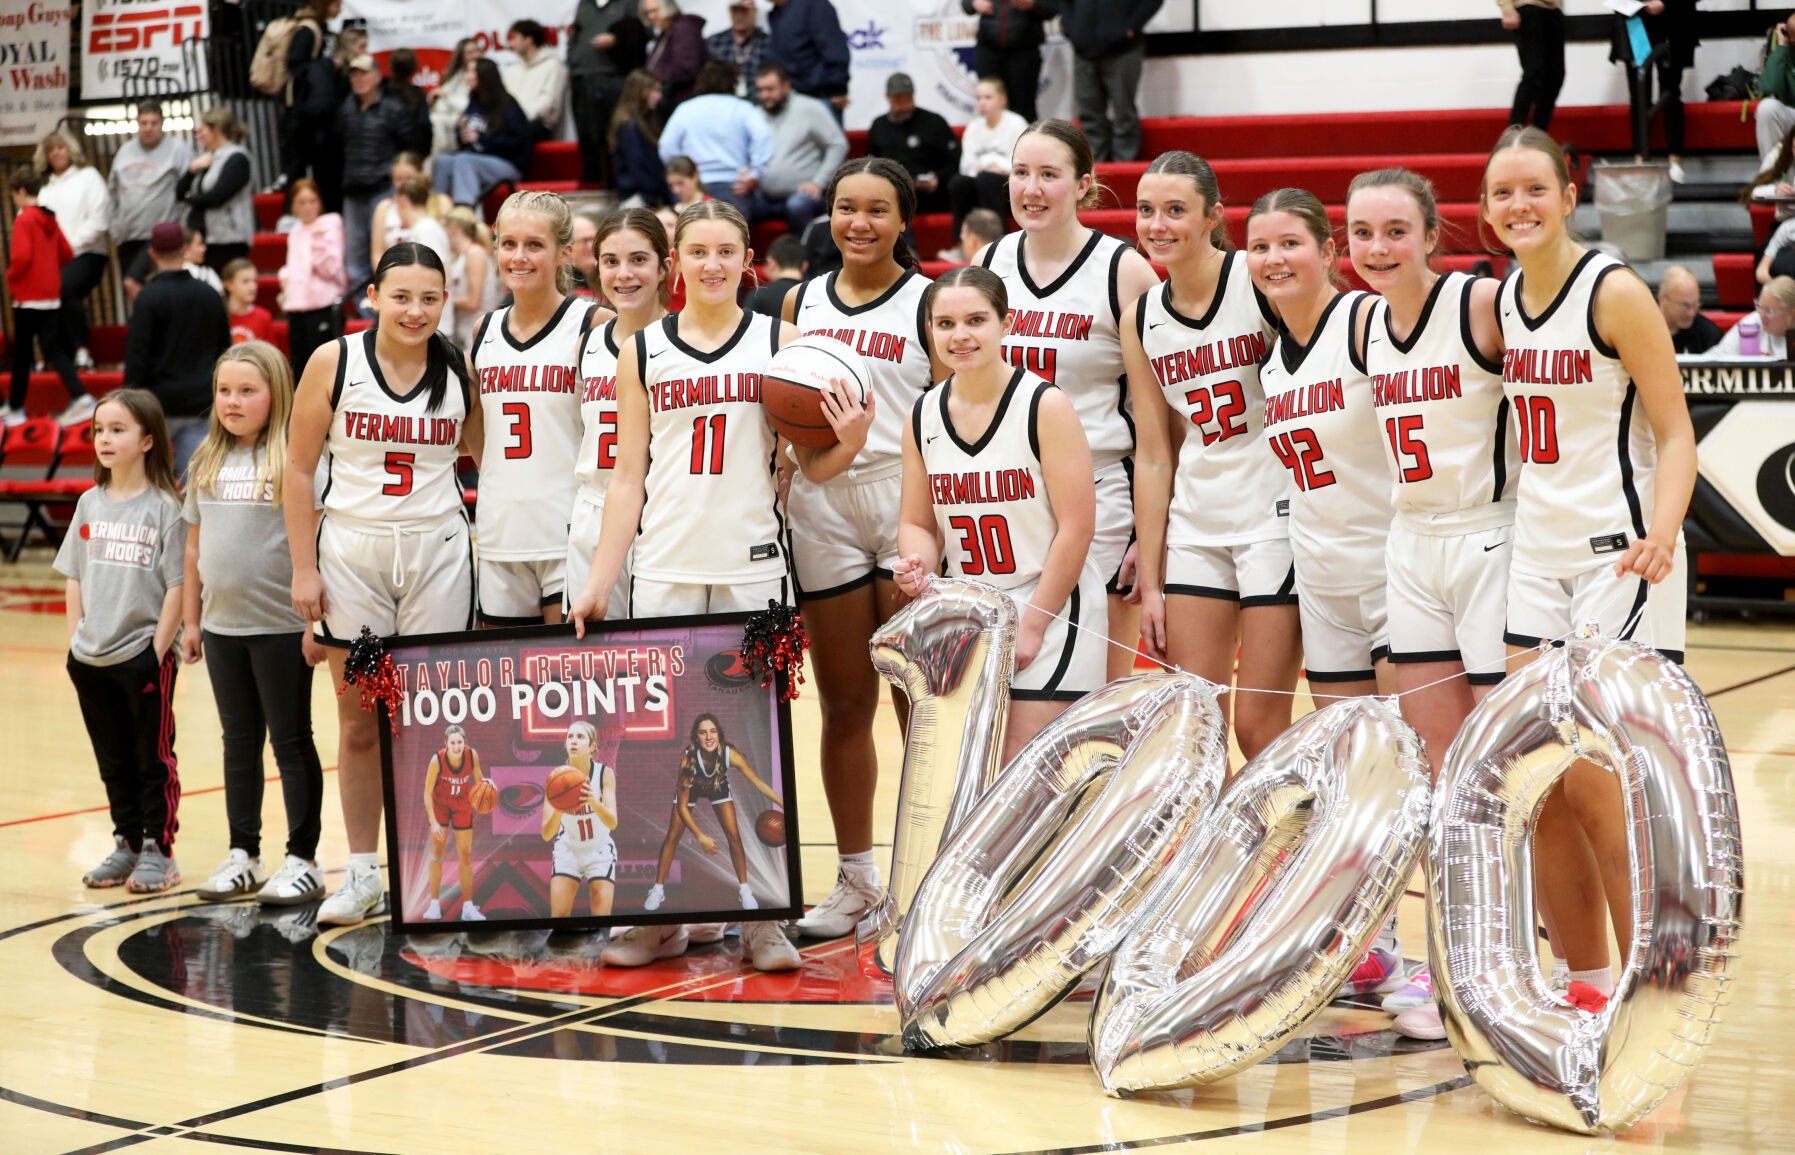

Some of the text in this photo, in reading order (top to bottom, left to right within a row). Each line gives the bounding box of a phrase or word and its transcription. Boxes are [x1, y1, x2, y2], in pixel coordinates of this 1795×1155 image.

[28, 3, 72, 26] Guys
[88, 5, 202, 55] ESPN
[10, 65, 67, 91] Wash
[113, 57, 159, 79] 1570
[1007, 308, 1094, 341] MILLION
[1151, 331, 1266, 387] VERMILLION
[1370, 364, 1462, 408] ERMILLION
[344, 411, 458, 446] VERMILLION
[502, 402, 532, 459] 3
[1184, 379, 1248, 447] 22
[1513, 395, 1559, 464] 10
[597, 411, 618, 469] 2
[690, 413, 727, 474] 11
[1268, 427, 1337, 492] 42
[1385, 413, 1434, 484] 15
[382, 451, 415, 497] 5
[105, 541, 152, 565] HOOPS
[948, 514, 1017, 575] 30
[397, 645, 685, 693] TAYLOR REUVERS
[399, 674, 669, 727] 1000 POINTS
[577, 818, 594, 842] 11
